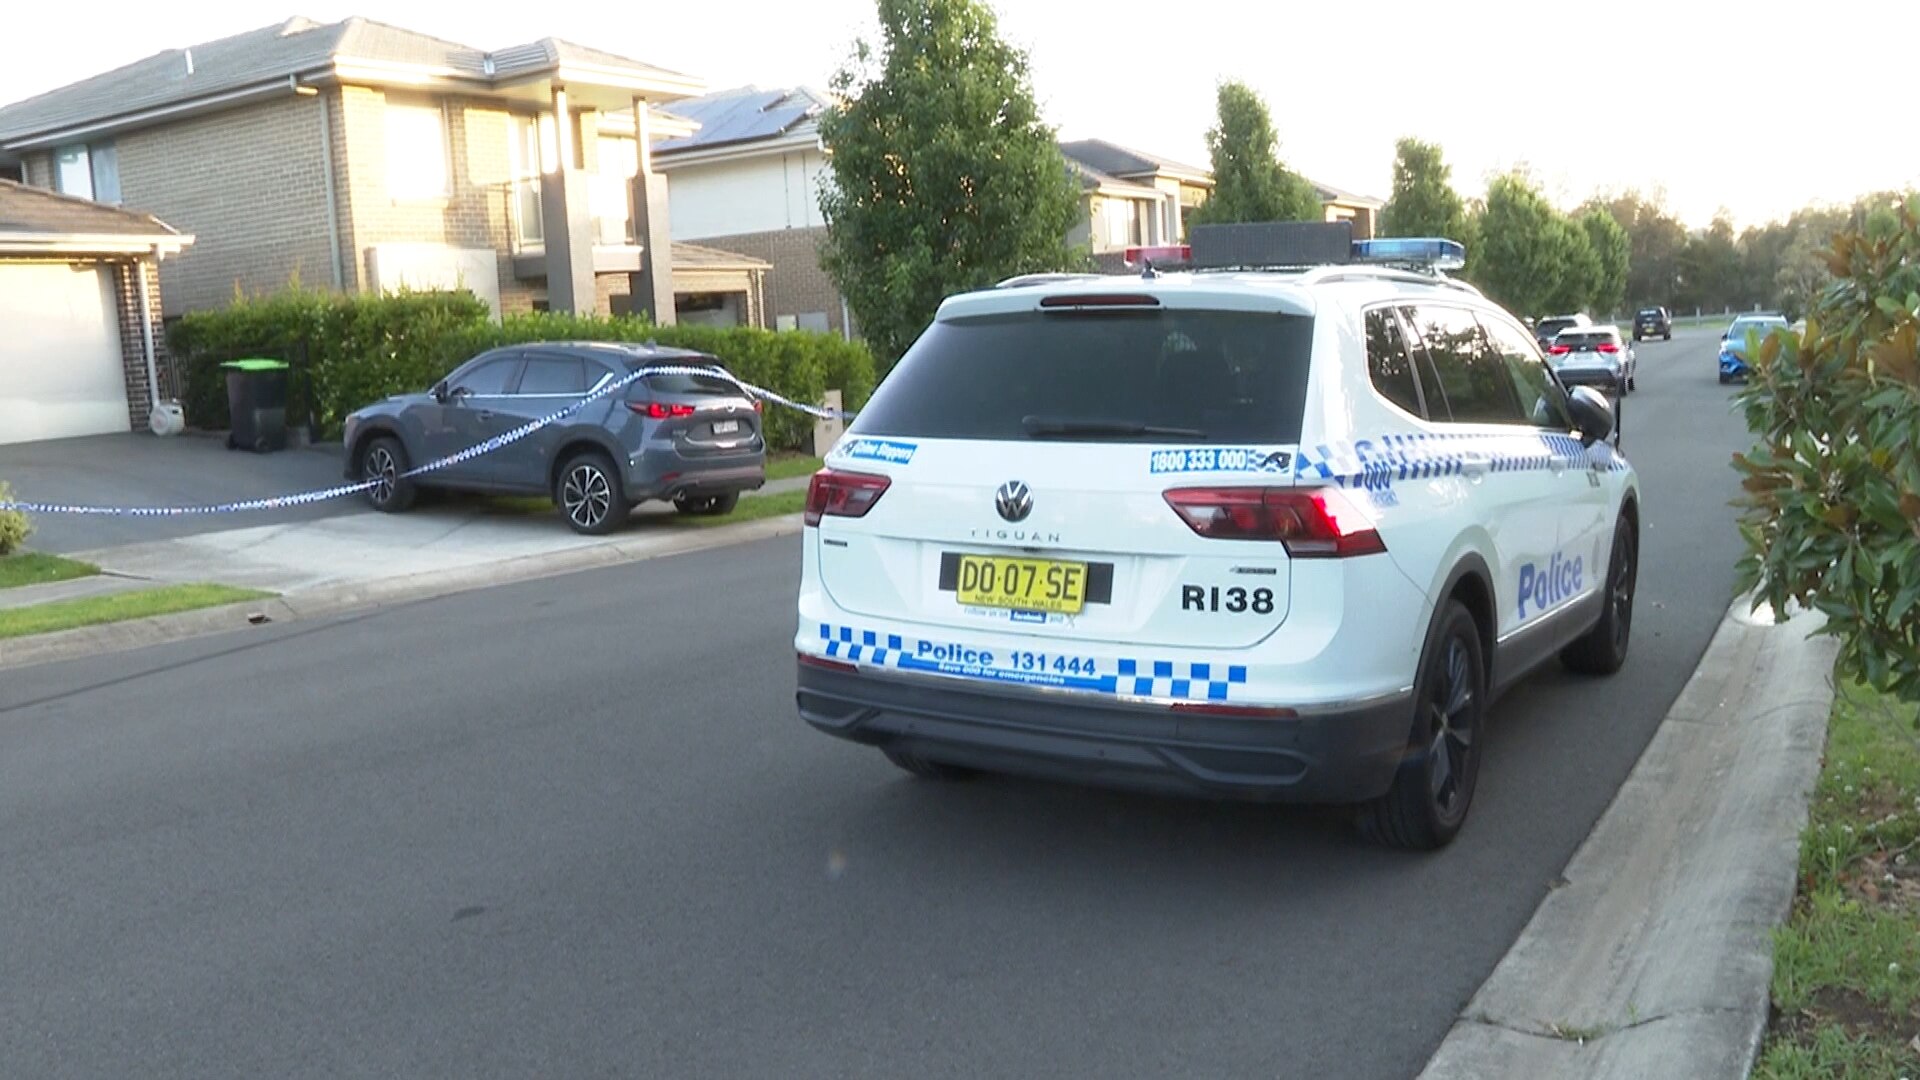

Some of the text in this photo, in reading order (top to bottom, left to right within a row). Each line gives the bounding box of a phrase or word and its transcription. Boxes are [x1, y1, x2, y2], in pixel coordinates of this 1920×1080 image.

[1152, 449, 1247, 471] 1800 333 000
[971, 528, 1061, 543] TIGUAN
[1518, 551, 1583, 620] Police
[998, 595, 1029, 606] SOUTH
[1032, 598, 1062, 610] WALES
[917, 640, 1096, 676] Police 131 444
[938, 662, 961, 673] Save
[982, 668, 996, 677] for
[998, 671, 1065, 685] emergencies
